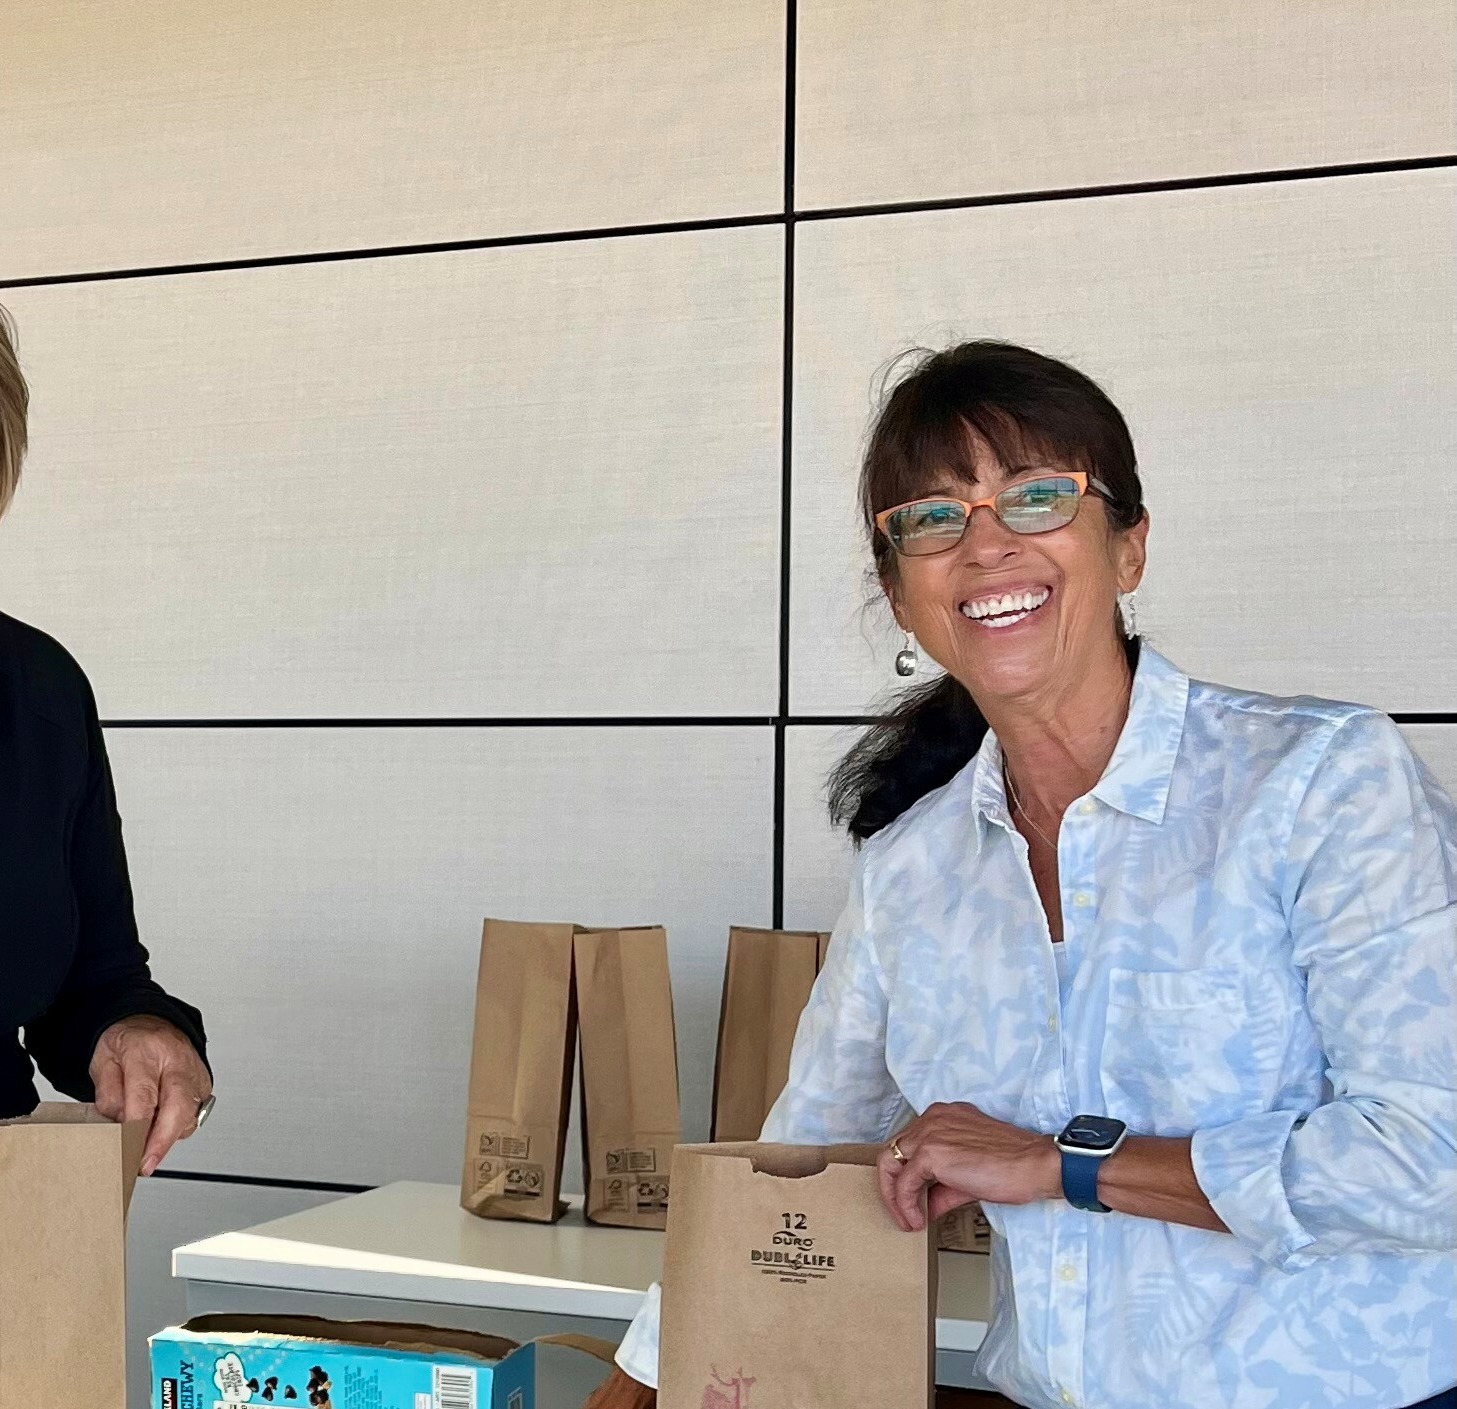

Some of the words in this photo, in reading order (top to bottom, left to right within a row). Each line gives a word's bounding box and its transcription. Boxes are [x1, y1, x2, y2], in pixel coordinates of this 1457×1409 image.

[782, 1213, 807, 1230] 12
[772, 1236, 813, 1247] DURO
[804, 1254, 835, 1267] LIFE
